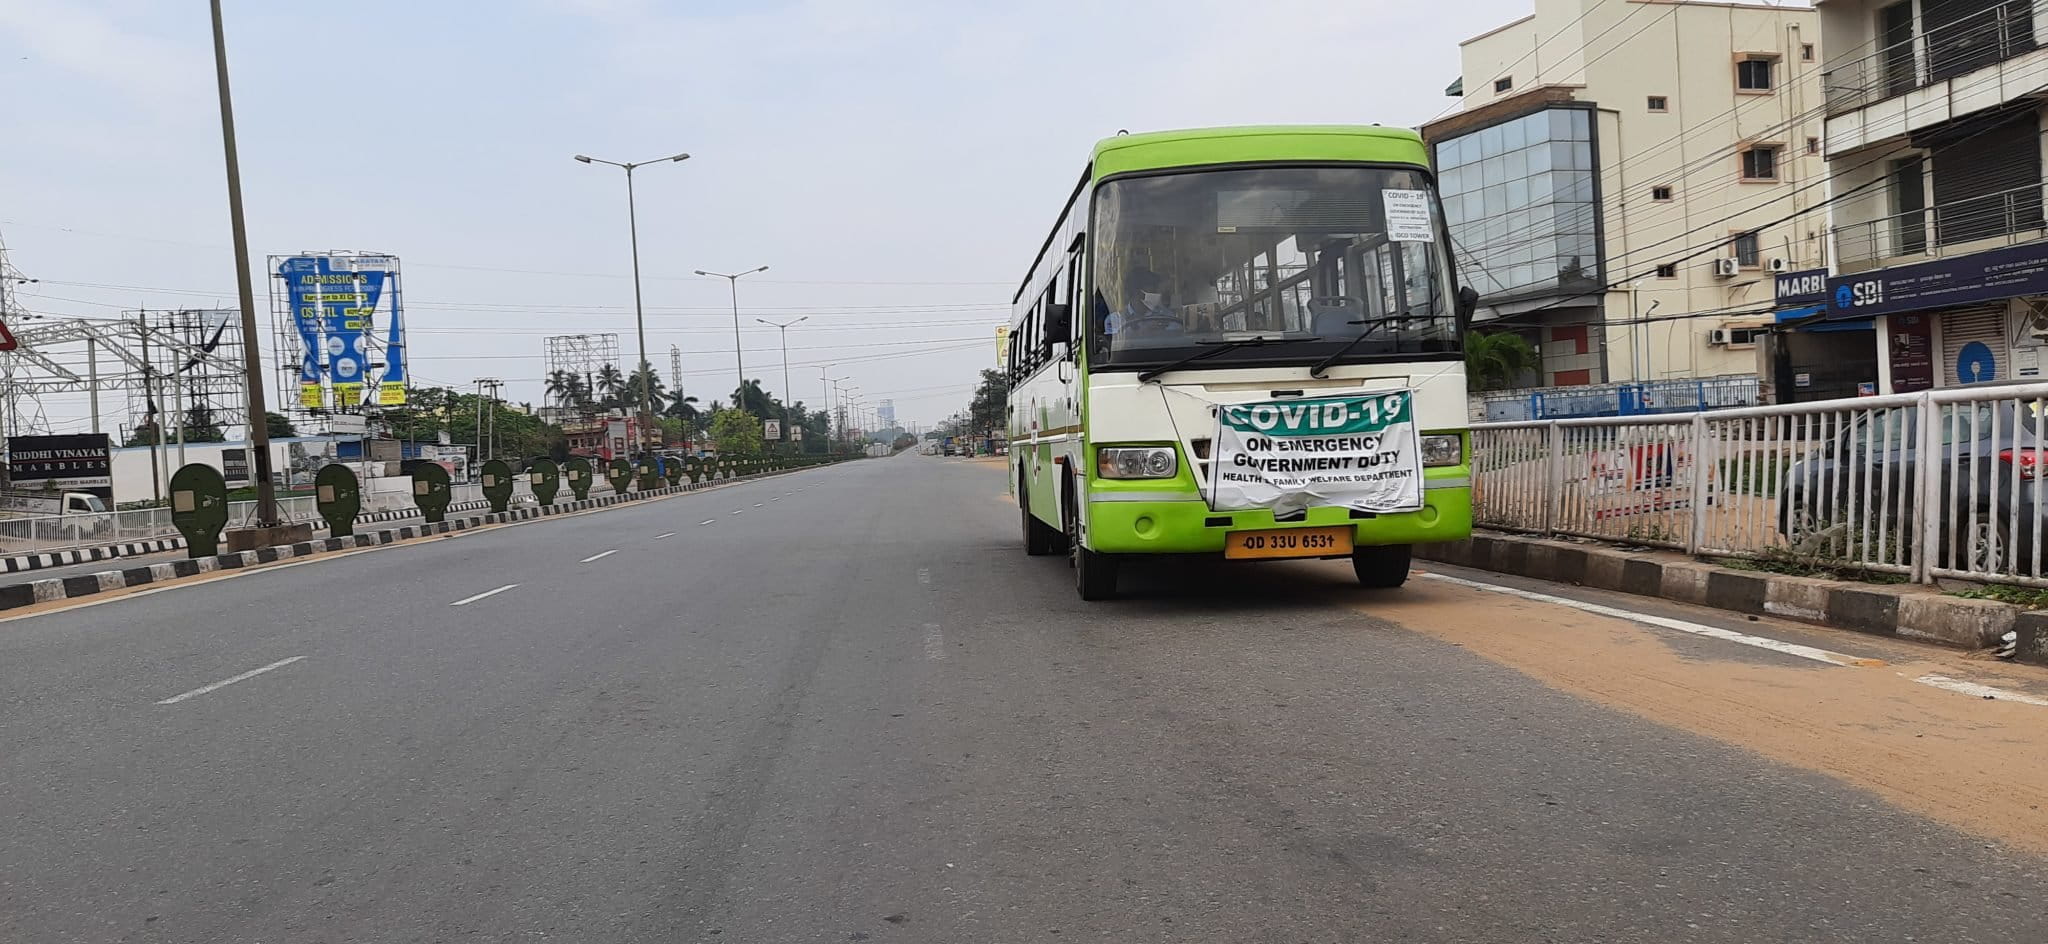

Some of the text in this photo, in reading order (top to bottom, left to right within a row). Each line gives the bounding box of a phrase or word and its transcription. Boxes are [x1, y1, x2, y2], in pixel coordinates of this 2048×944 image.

[301, 274, 368, 285] ADMISSIOS
[1853, 280, 1883, 306] SBI
[1224, 395, 1402, 430] COVID-19
[1246, 433, 1384, 452] ON EMERGENCY
[12, 447, 106, 460] SIDDHI VINAYAK
[13, 461, 106, 473] MARBLES
[1233, 450, 1400, 473] GOVERNMENT DUTY
[1222, 472, 1262, 483] HEALTH
[1308, 475, 1352, 483] WELFARE
[1354, 469, 1412, 482] DEPARTMENT
[1246, 536, 1265, 549] OD
[1270, 535, 1297, 549] 33U
